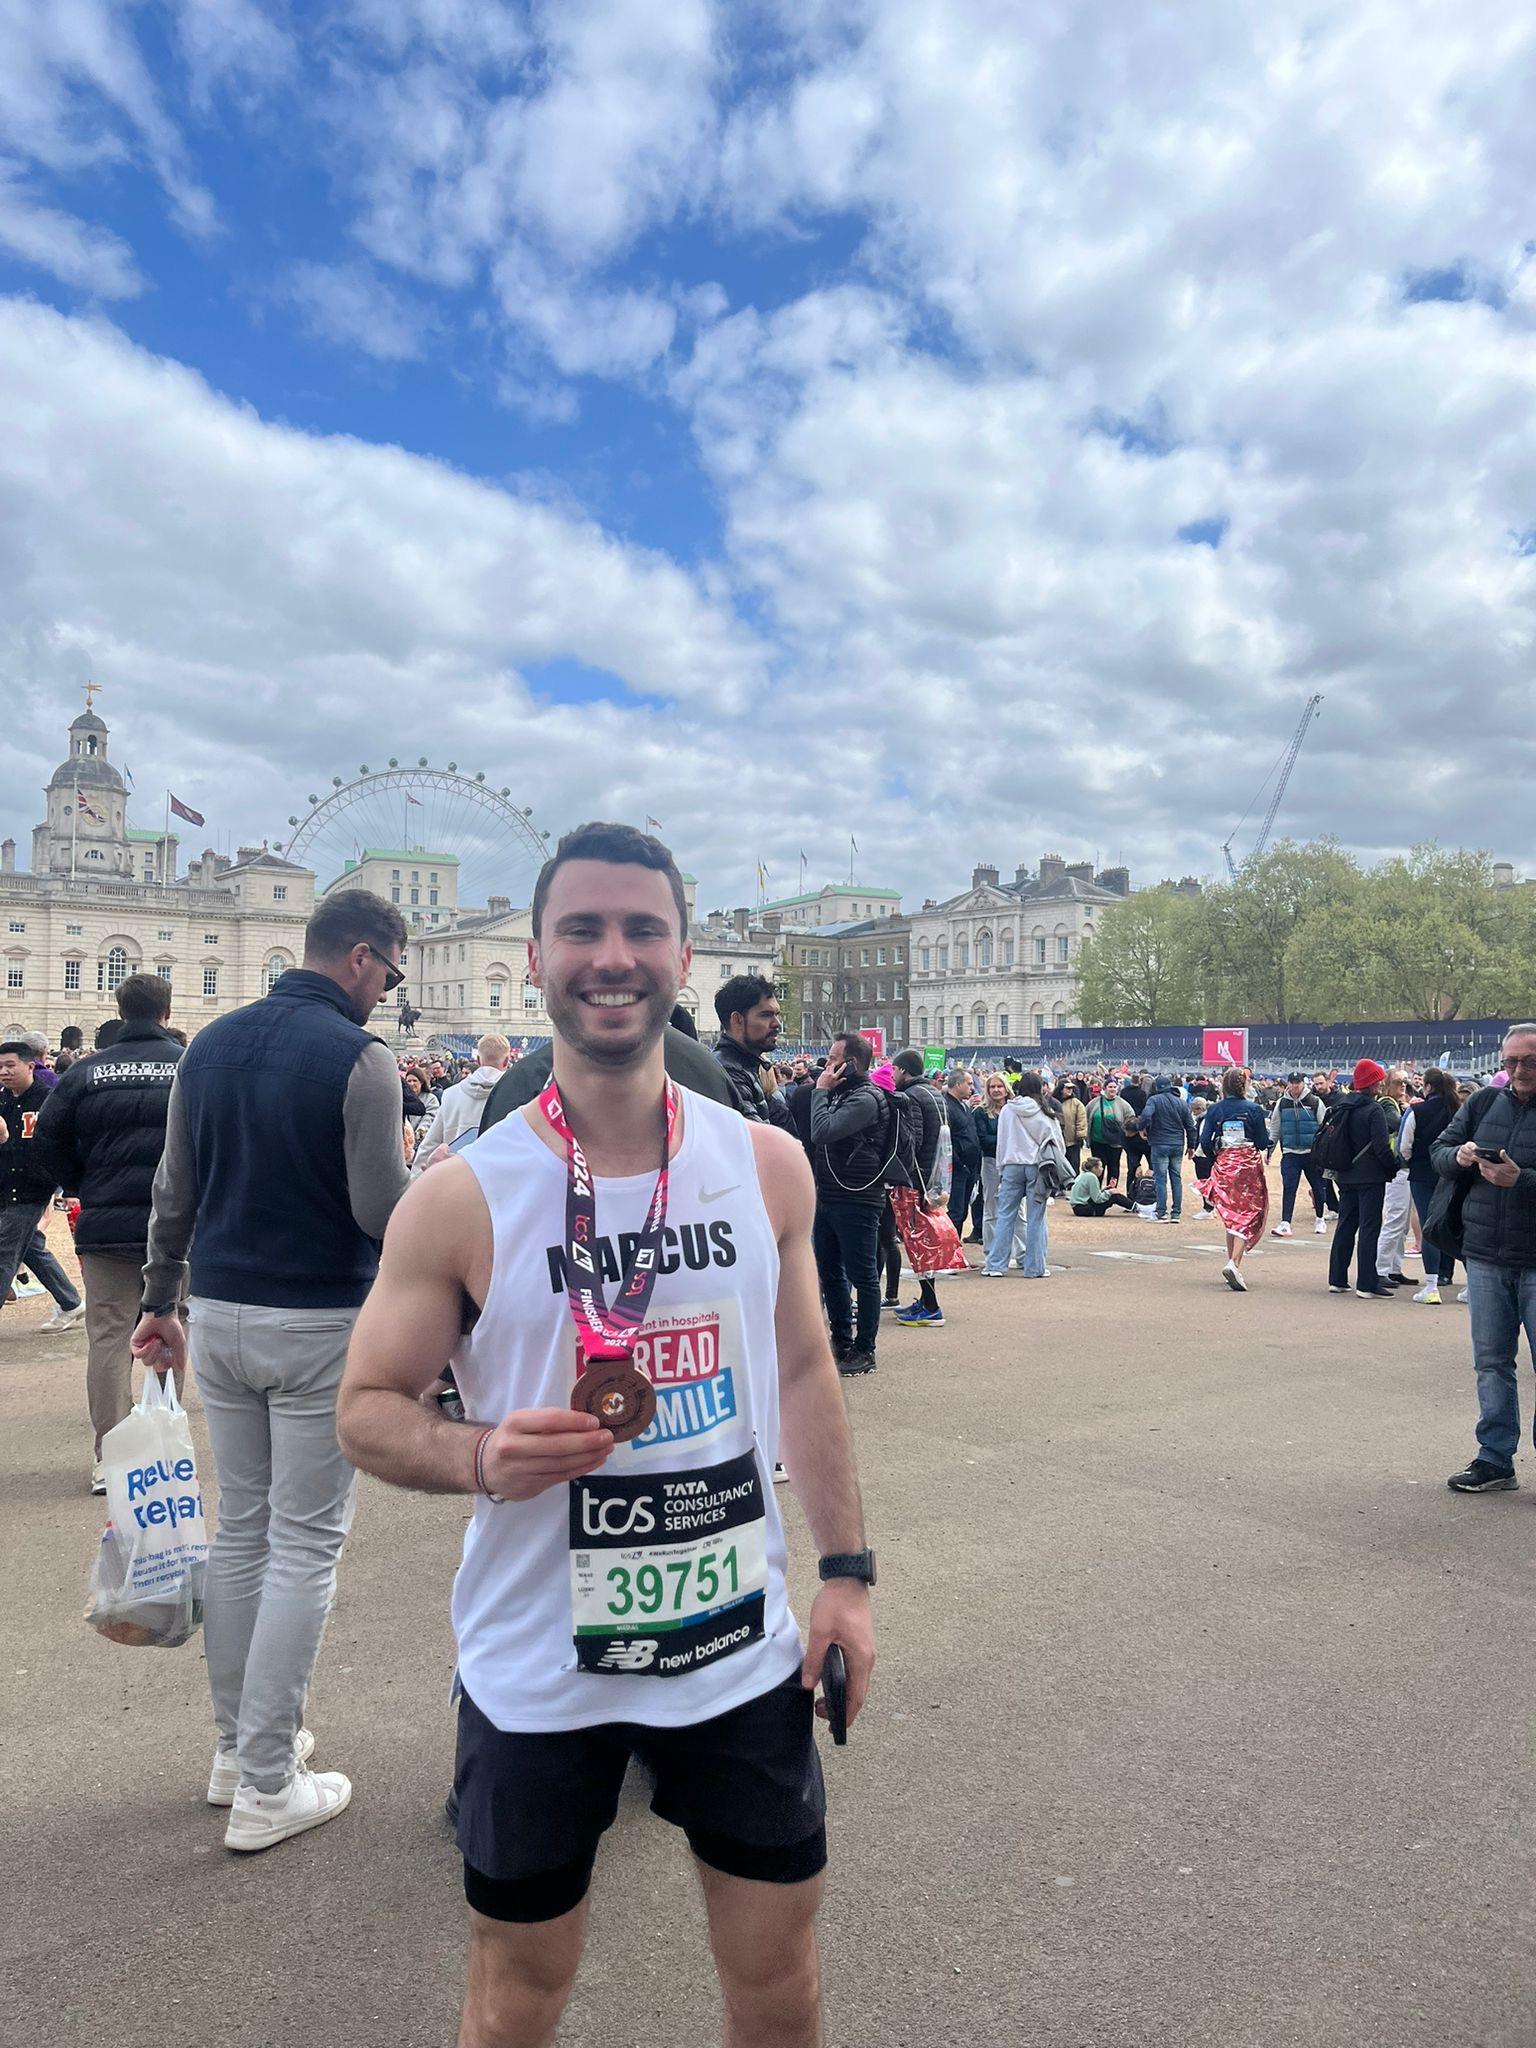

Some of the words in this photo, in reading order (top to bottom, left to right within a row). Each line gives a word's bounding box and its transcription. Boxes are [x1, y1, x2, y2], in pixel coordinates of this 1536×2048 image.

[580, 1288, 603, 1333] FINISHER
[658, 1319, 669, 1327] in
[671, 1311, 720, 1326] hospitals
[663, 1480, 708, 1496] TATA
[663, 1480, 754, 1515] CONSULTANCY
[582, 1487, 656, 1536] tcs
[665, 1506, 726, 1531] SERVICES
[606, 1545, 739, 1616] 39751
[660, 1647, 692, 1669] new
[695, 1624, 751, 1659] balance
